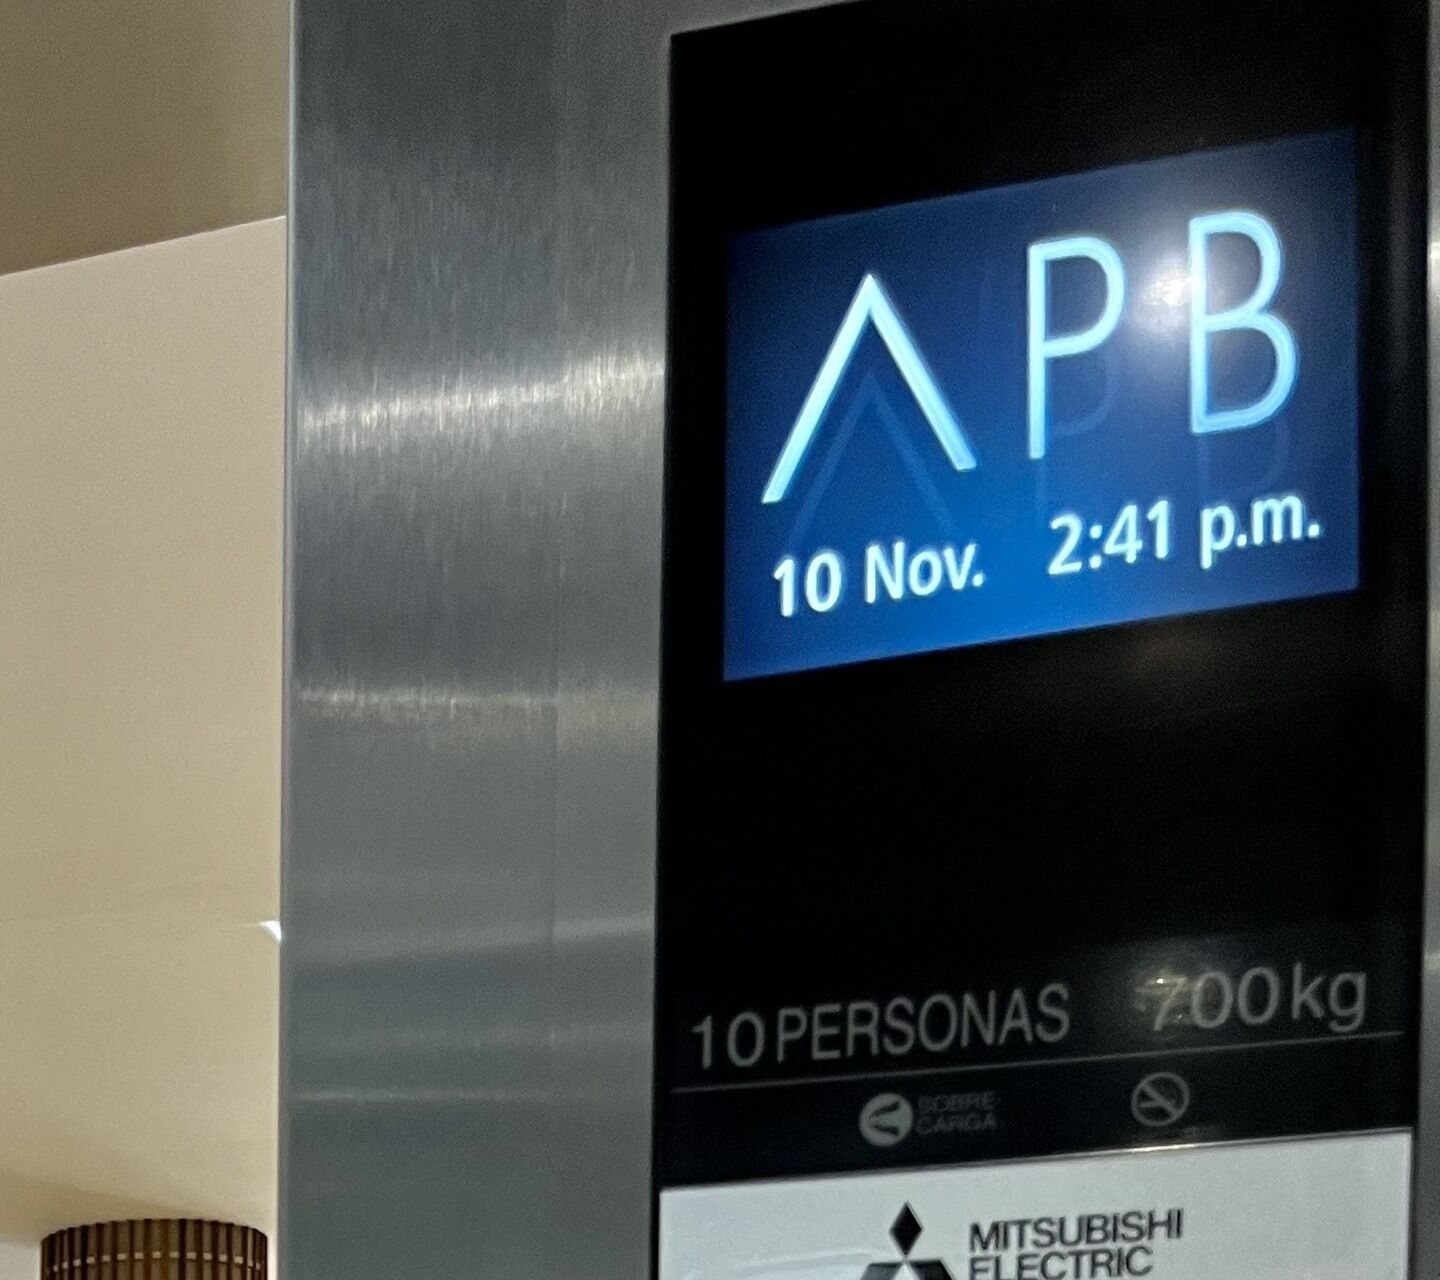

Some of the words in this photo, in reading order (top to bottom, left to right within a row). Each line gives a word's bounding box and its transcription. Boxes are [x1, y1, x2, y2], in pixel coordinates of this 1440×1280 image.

[773, 552, 842, 617] 10
[864, 540, 986, 603] Nov.
[1047, 500, 1172, 575] 2:41
[1200, 493, 1322, 569] p.m.
[968, 1207, 1184, 1253] MITSUBISHI
